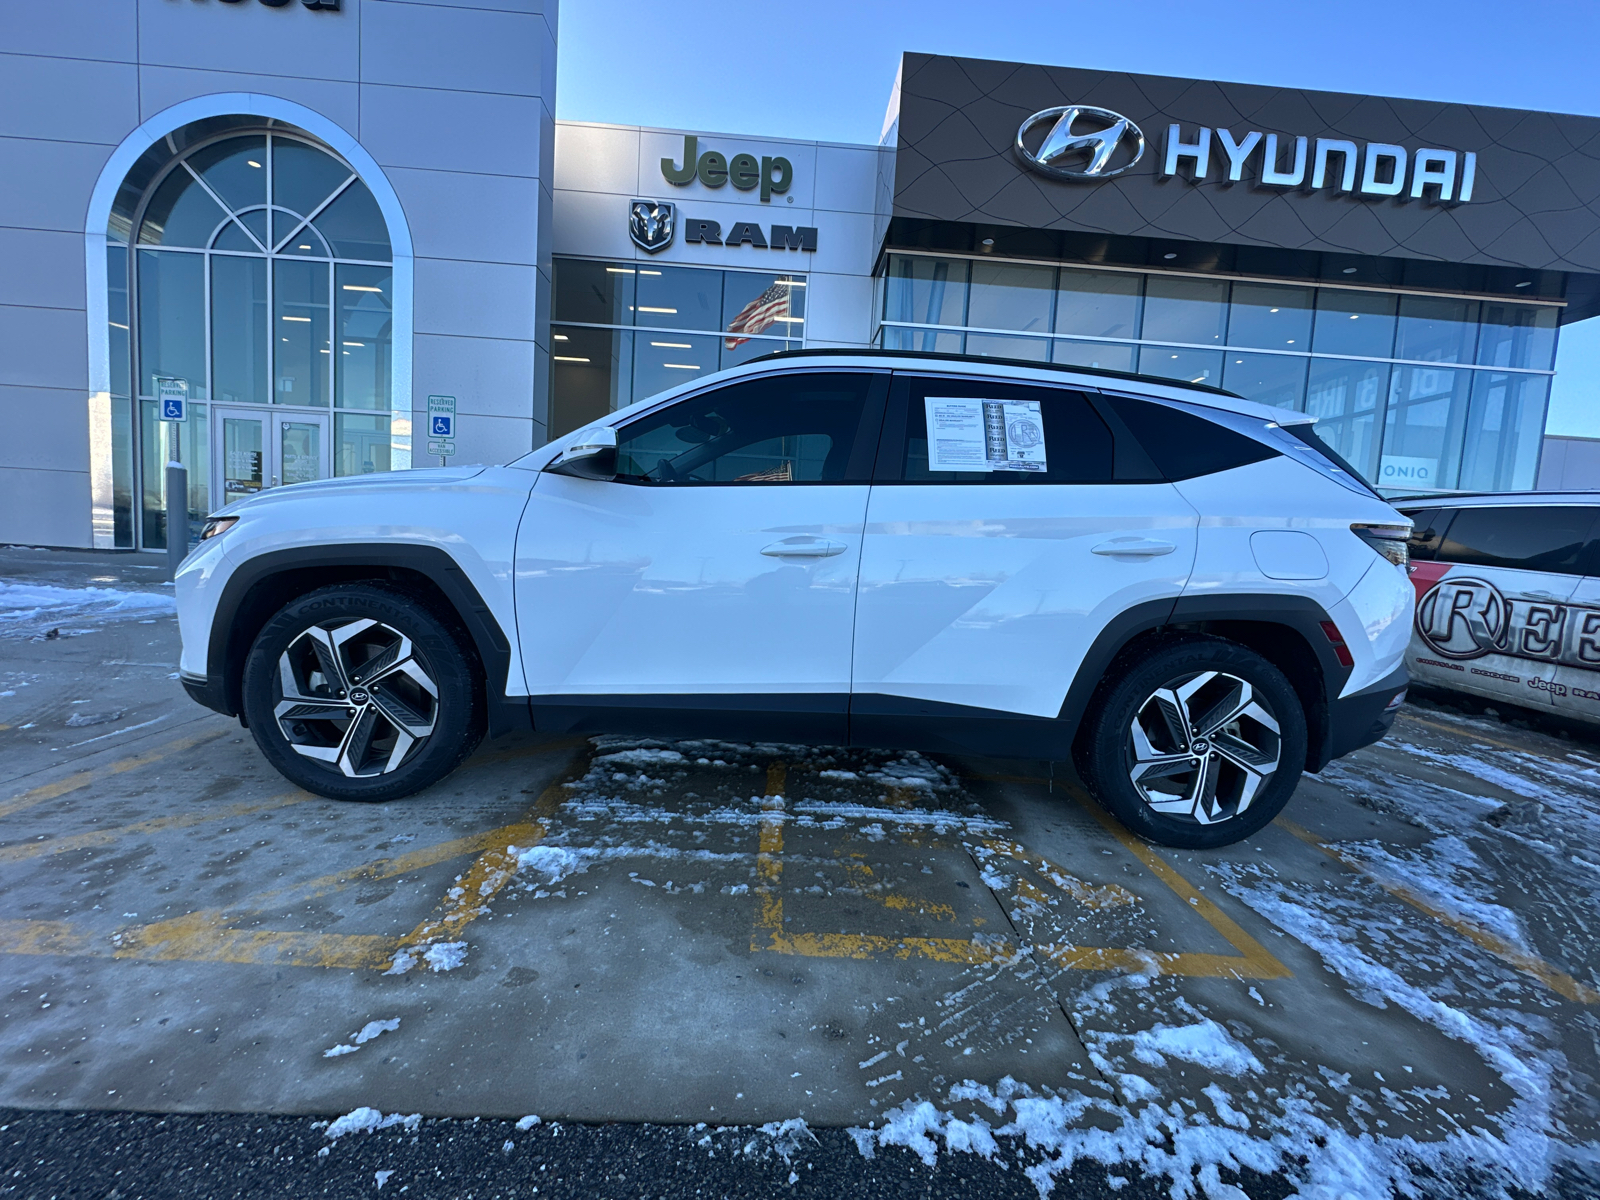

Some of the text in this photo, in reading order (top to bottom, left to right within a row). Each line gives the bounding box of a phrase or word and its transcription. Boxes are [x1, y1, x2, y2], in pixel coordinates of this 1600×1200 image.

[661, 135, 793, 202] Jeep
[1160, 123, 1477, 203] HYUNDAI
[685, 218, 818, 252] RAM
[430, 398, 453, 406] RESERVED
[430, 405, 453, 413] PARKING
[298, 596, 422, 634] CONTINENTAL
[1416, 657, 1465, 671] CHRYSLER
[1471, 667, 1520, 683] DODGE
[1527, 677, 1567, 697] Jeep
